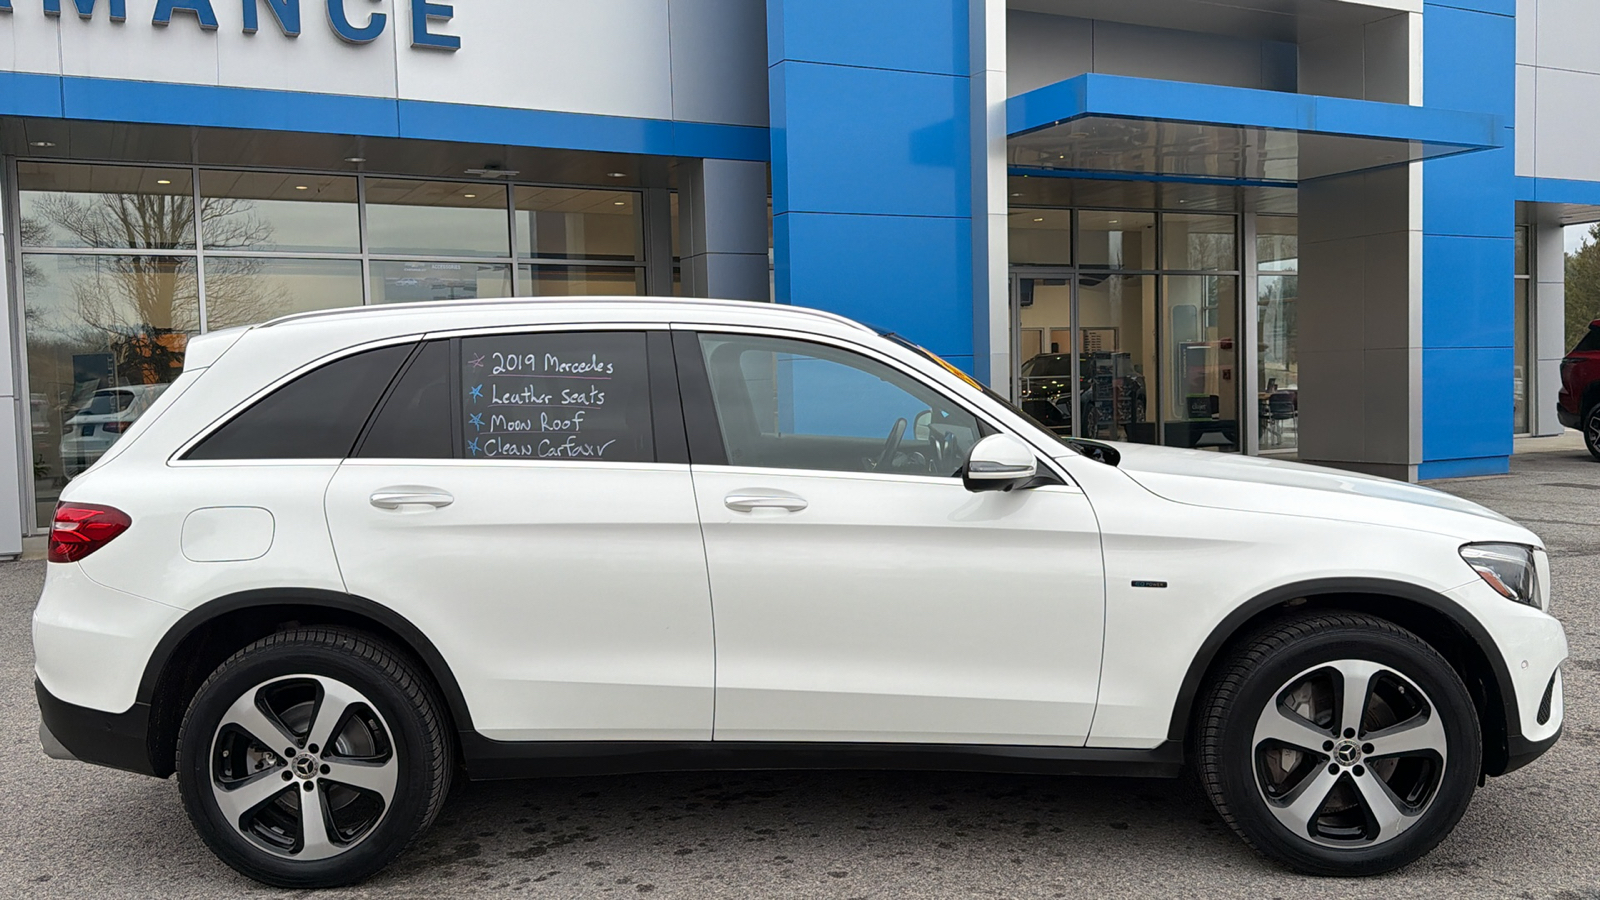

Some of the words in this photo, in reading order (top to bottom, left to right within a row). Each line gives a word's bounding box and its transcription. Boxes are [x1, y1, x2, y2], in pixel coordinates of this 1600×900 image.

[492, 352, 536, 374] 2019
[544, 353, 614, 374] Mercedes
[492, 384, 552, 404] Leather
[541, 411, 585, 432] Roof
